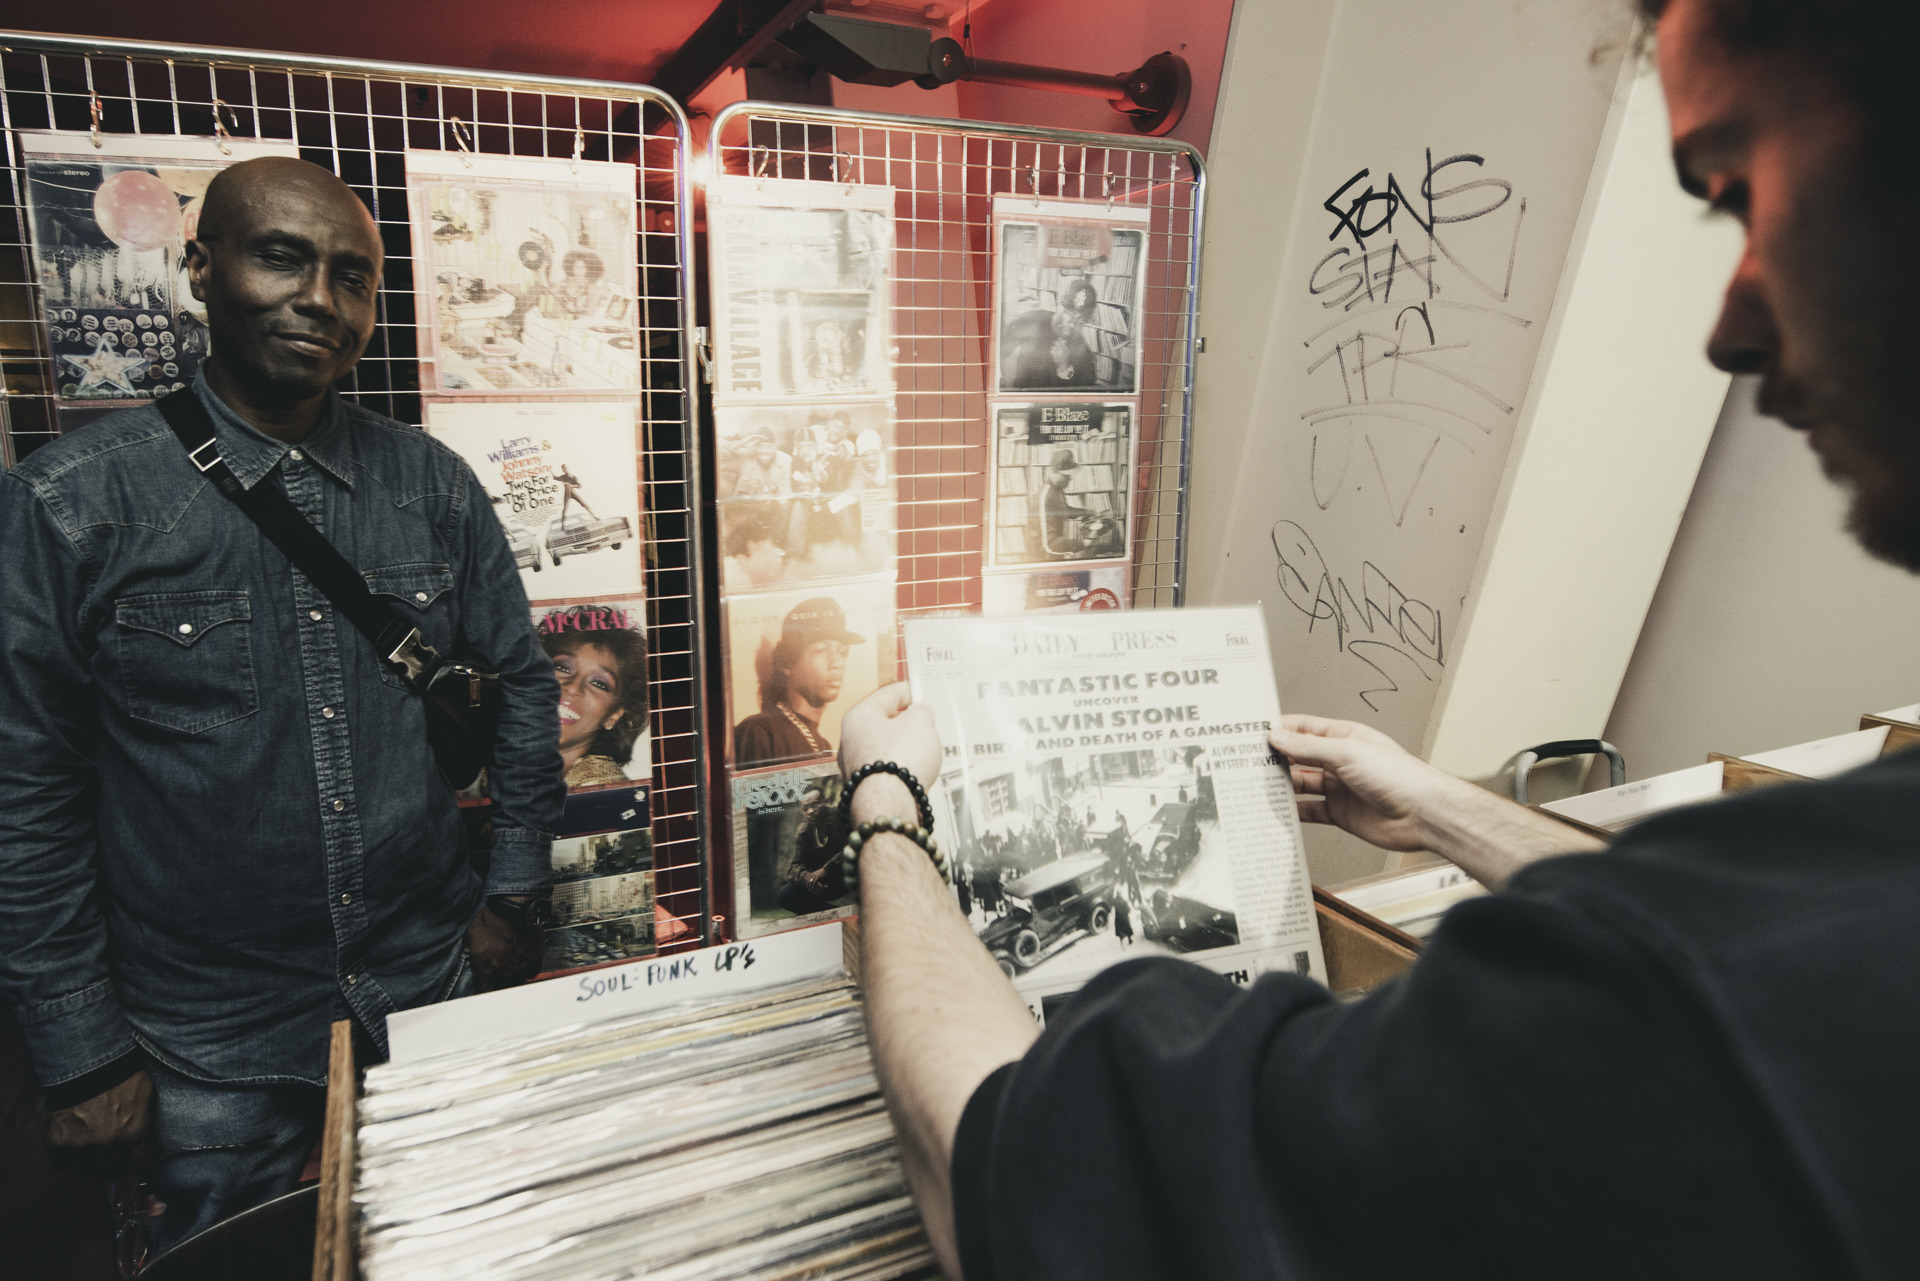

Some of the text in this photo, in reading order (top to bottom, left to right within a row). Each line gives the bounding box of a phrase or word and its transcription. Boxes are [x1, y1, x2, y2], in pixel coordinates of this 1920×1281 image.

[63, 169, 90, 177] stereo
[728, 289, 762, 392] VILLAGE
[1040, 407, 1090, 423] E Blaze
[486, 440, 552, 463] Williams &
[500, 435, 533, 450] Larry
[501, 455, 543, 472] Johnny
[500, 465, 551, 483] Watson
[505, 475, 550, 493] Two For
[502, 485, 559, 505] The Price
[512, 495, 556, 514] Of One
[1083, 592, 1117, 611] LIMITED EDITION
[926, 629, 1250, 663] FINAL DAILY PRESS FINAL
[977, 668, 1219, 700] FANTASTIC FOUR
[1073, 695, 1139, 708] UNCOVER
[1018, 705, 1200, 734] ALVIN STONE
[1035, 737, 1074, 751] AND
[1079, 732, 1137, 747] DEATH
[1142, 729, 1163, 742] OF
[1168, 728, 1180, 739] A
[1184, 720, 1272, 738] GANGSTER
[1212, 743, 1263, 757] ALVIN STONE
[1214, 754, 1281, 771] MYSTERY SOLVED
[765, 805, 785, 814] here.
[648, 956, 698, 986] FUNK
